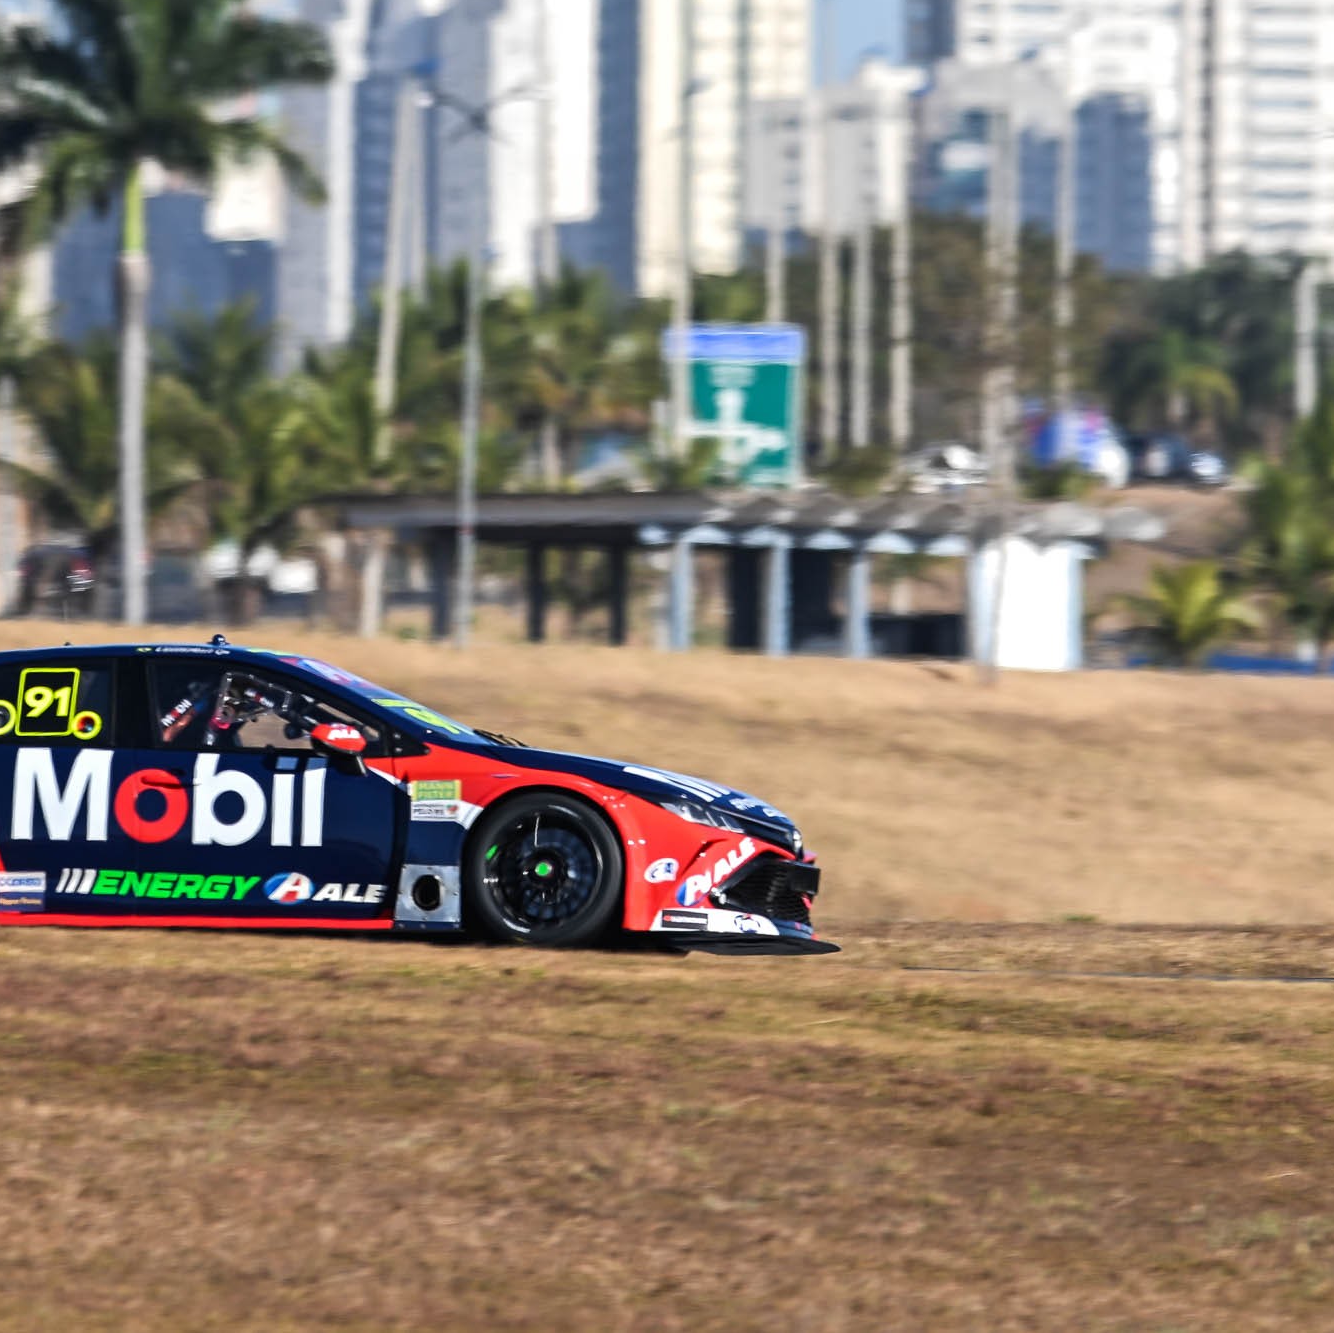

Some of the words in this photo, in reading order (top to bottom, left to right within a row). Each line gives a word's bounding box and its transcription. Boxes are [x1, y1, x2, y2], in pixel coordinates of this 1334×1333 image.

[24, 686, 72, 717] 91
[10, 747, 328, 847] Mobil
[713, 836, 756, 884] ALE
[92, 869, 260, 900] ENERGY
[312, 882, 388, 903] ALE
